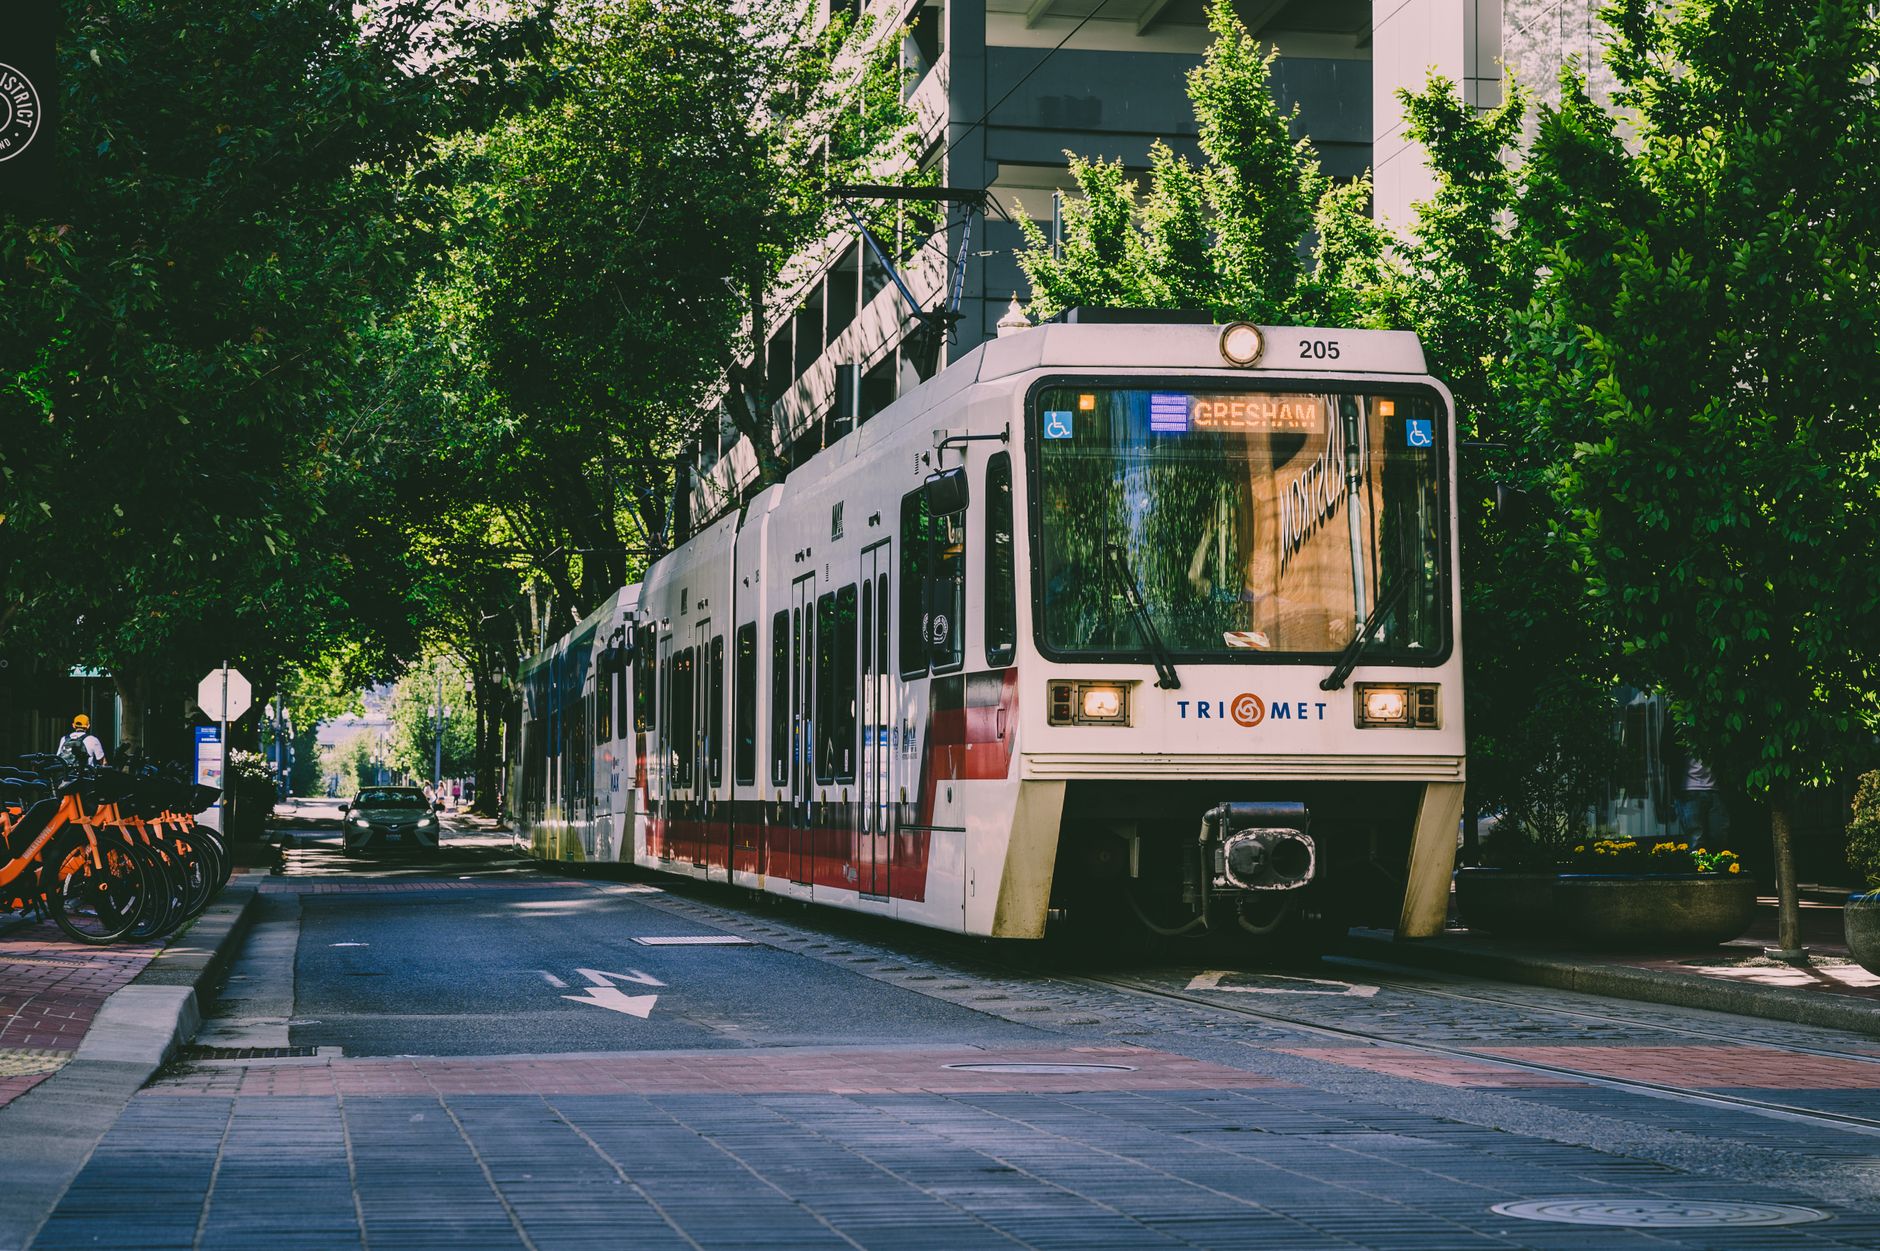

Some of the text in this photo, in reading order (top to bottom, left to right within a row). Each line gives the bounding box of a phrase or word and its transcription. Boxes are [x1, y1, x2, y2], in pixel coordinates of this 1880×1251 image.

[0, 72, 34, 129] ISTRICT
[1299, 340, 1340, 360] 205
[1194, 402, 1316, 427] GRESHAM
[1176, 701, 1327, 720] TRI MET
